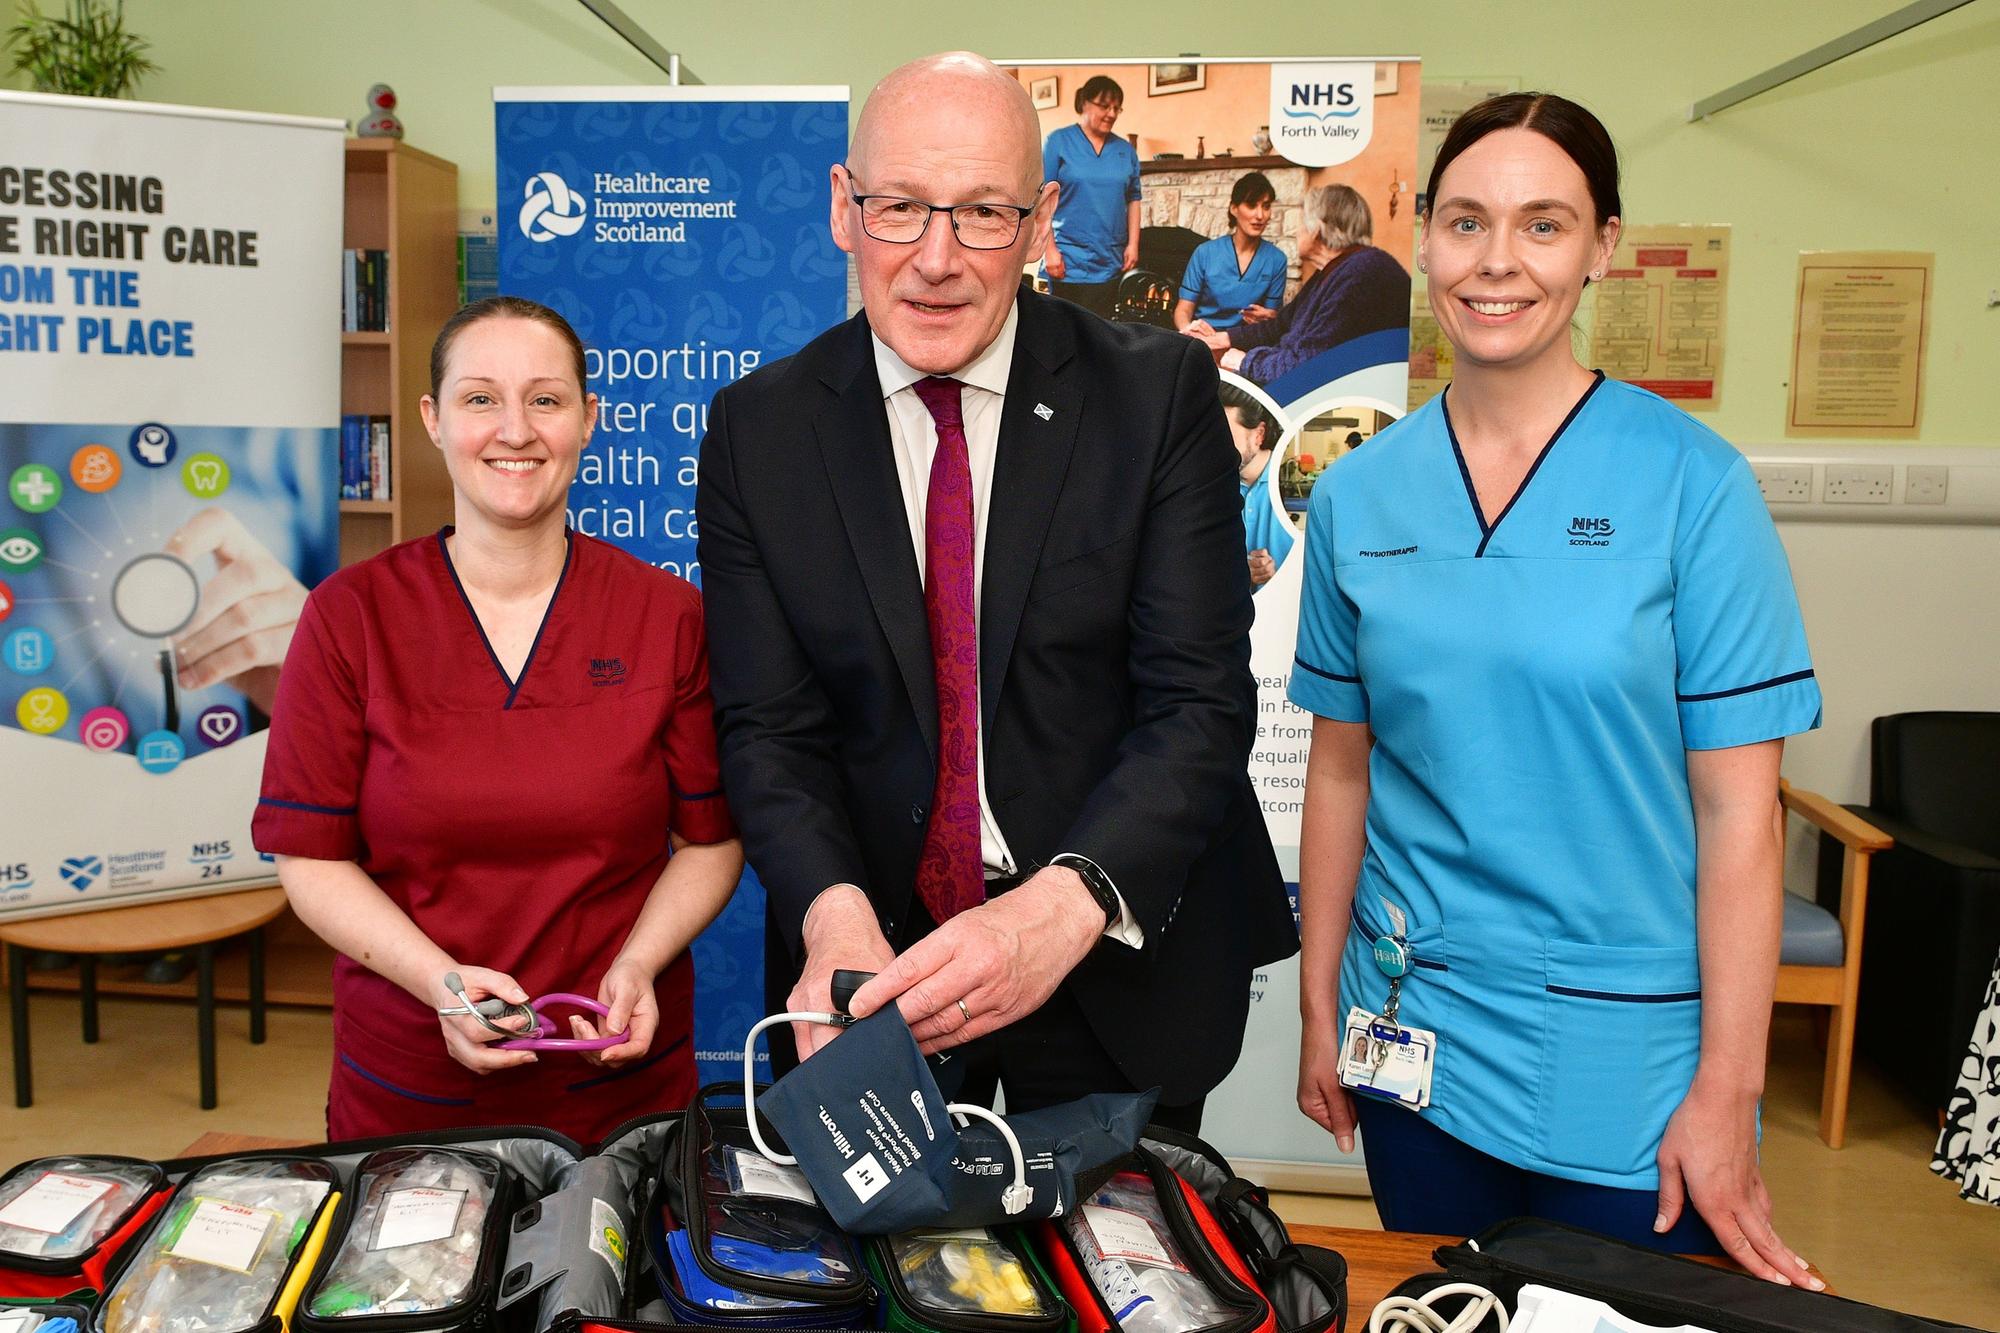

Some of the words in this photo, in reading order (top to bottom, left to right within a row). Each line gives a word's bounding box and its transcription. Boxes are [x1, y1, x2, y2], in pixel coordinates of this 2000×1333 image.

[1291, 83, 1354, 106] NHS
[1281, 125, 1317, 138] Forth
[1322, 125, 1360, 141] Valley
[594, 173, 710, 194] Healthcare
[594, 198, 736, 223] Improvement
[594, 221, 685, 243] Scotland
[34, 220, 148, 260] RIGHT
[164, 227, 259, 267] CARE
[68, 268, 140, 308] THE
[77, 316, 195, 357] PLACE
[572, 446, 659, 486] alth
[1572, 516, 1610, 532] NHS
[1358, 545, 1418, 558] PHYSIOTHERAPIST
[1568, 538, 1610, 547] SCOTLAND
[1260, 699, 1276, 713] in
[192, 840, 231, 857] NHS
[201, 865, 222, 878] 24
[1399, 1045, 1415, 1056] NHS
[864, 1088, 882, 1108] Cuff
[859, 1098, 886, 1133] Reusable
[879, 1105, 905, 1139] Pressure
[901, 1136, 922, 1160] Blood
[883, 1149, 903, 1176] Welch
